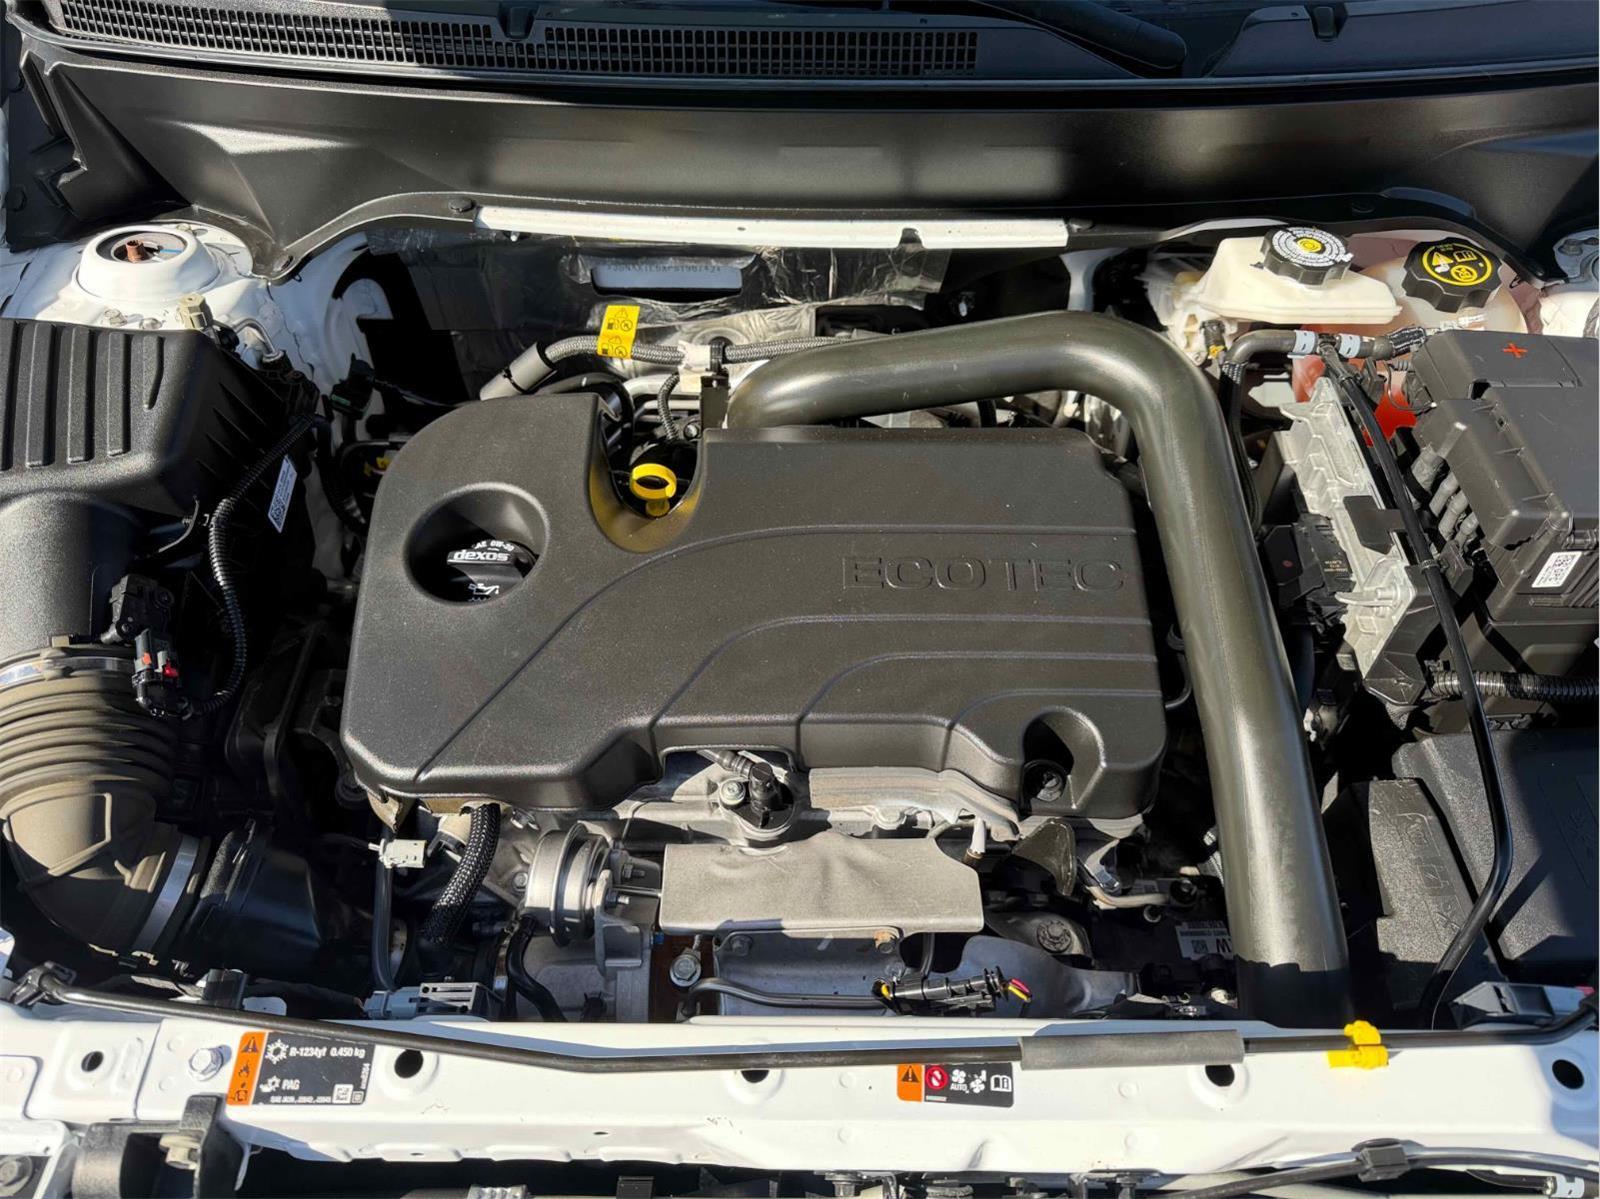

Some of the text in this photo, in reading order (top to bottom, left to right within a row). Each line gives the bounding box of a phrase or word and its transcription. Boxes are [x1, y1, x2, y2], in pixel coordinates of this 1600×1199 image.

[453, 549, 511, 562] dexos
[842, 557, 1124, 592] ECOTEC
[330, 1047, 353, 1057] 0.450
[354, 1047, 366, 1059] kg
[281, 1079, 300, 1090] PAG
